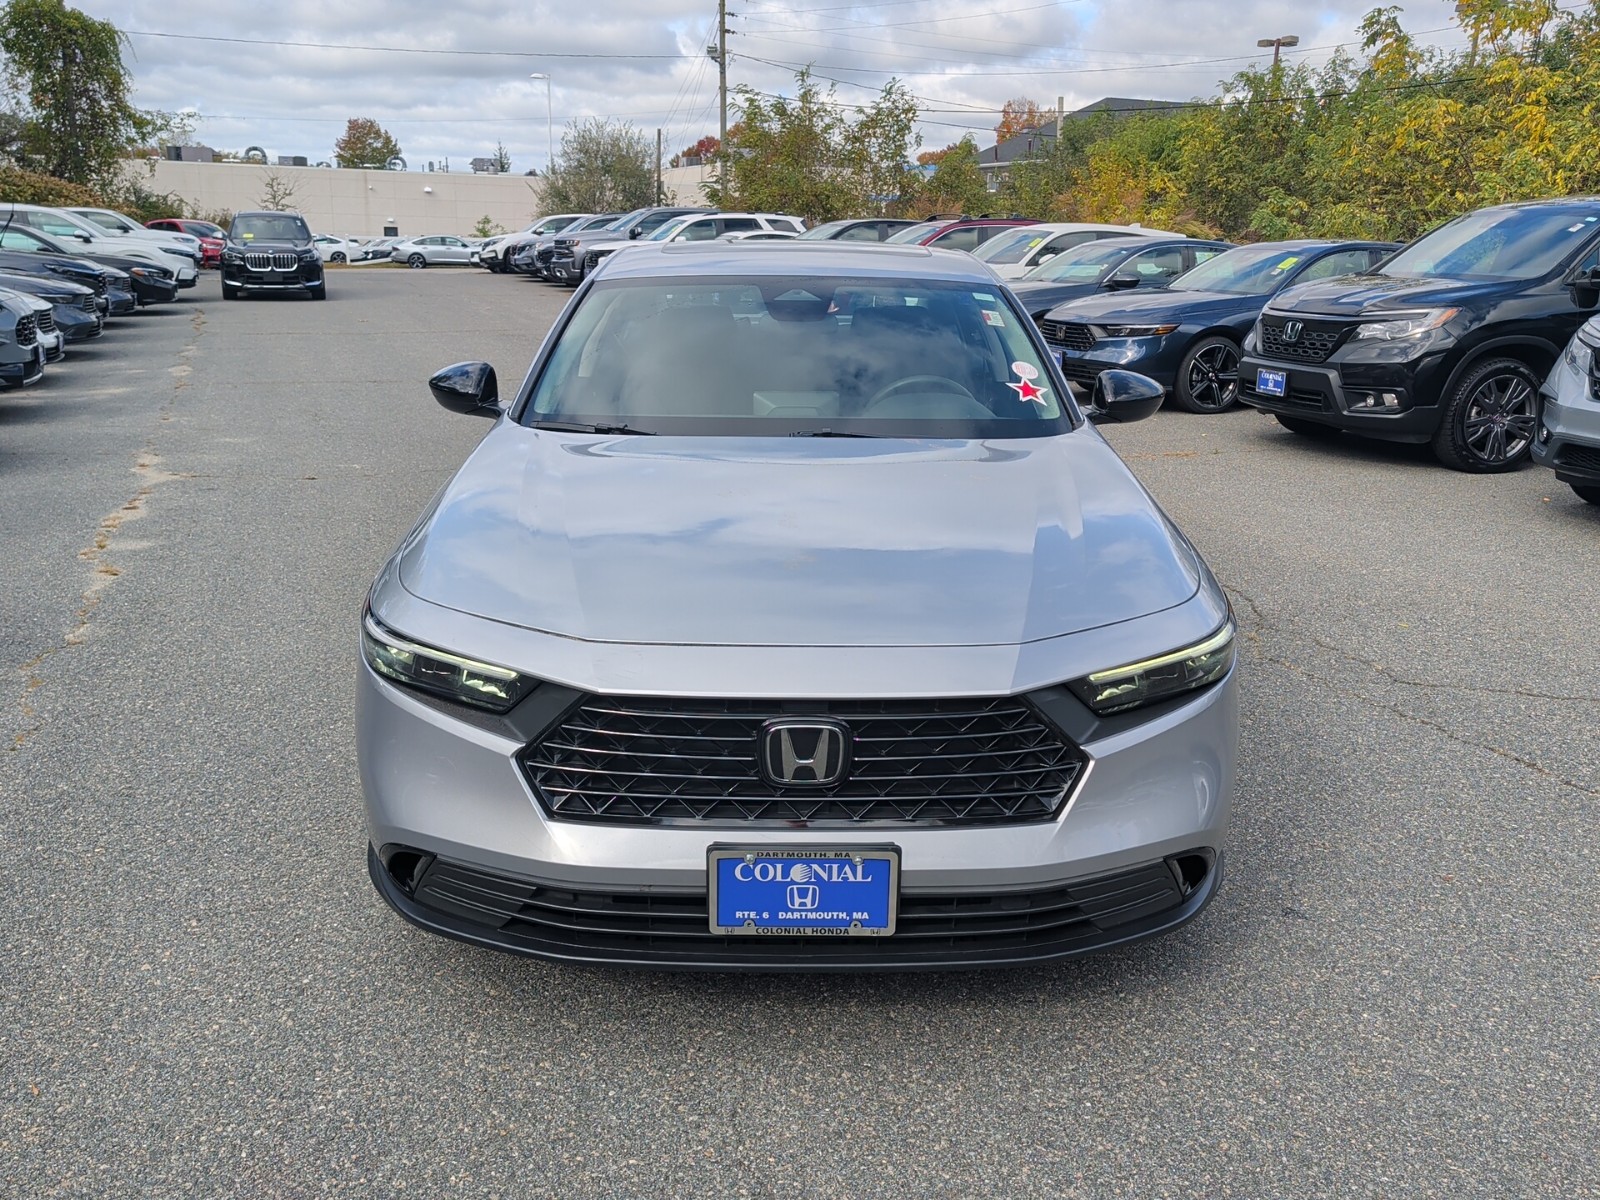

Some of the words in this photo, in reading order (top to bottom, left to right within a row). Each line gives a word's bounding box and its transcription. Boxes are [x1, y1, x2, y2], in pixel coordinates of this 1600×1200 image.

[734, 862, 873, 882] COLONIAL
[735, 911, 760, 919] RTE.
[762, 911, 770, 919] 6
[778, 911, 850, 920] DARTMOUTH,
[852, 912, 870, 920] MA
[755, 927, 808, 935] COLONIAL
